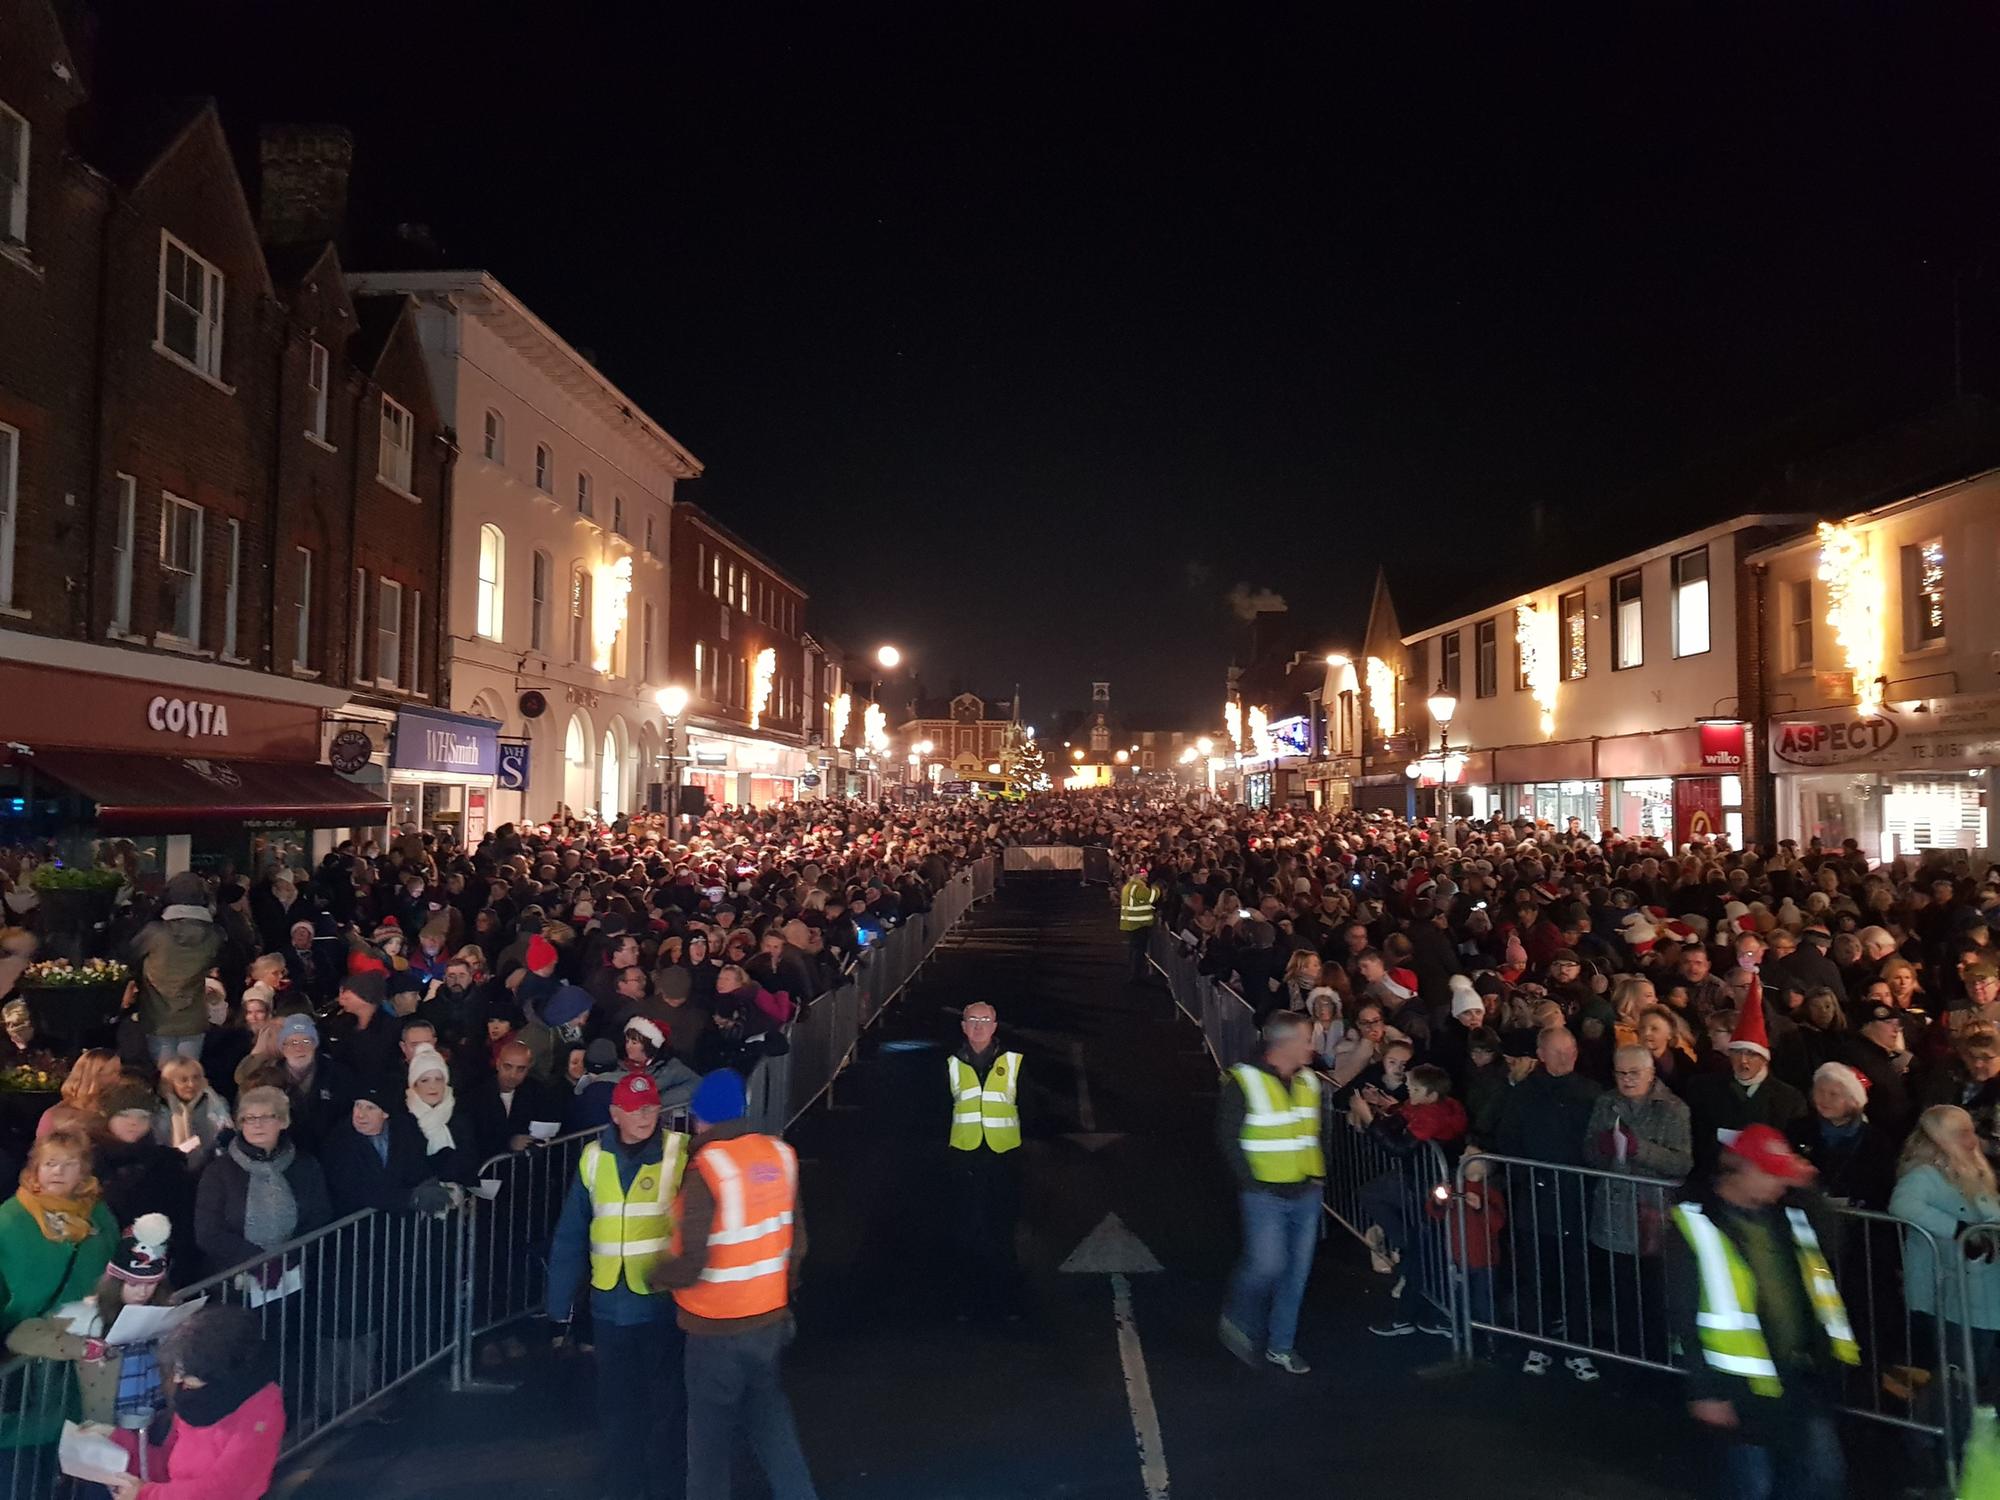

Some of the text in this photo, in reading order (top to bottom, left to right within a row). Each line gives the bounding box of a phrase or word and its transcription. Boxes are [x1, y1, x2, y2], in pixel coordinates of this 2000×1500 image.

[148, 696, 228, 738] COSTA
[427, 729, 479, 765] WHSmith
[504, 745, 525, 757] WH
[1780, 720, 1885, 753] ASPECT
[502, 756, 523, 788] S
[1705, 750, 1740, 764] wilko
